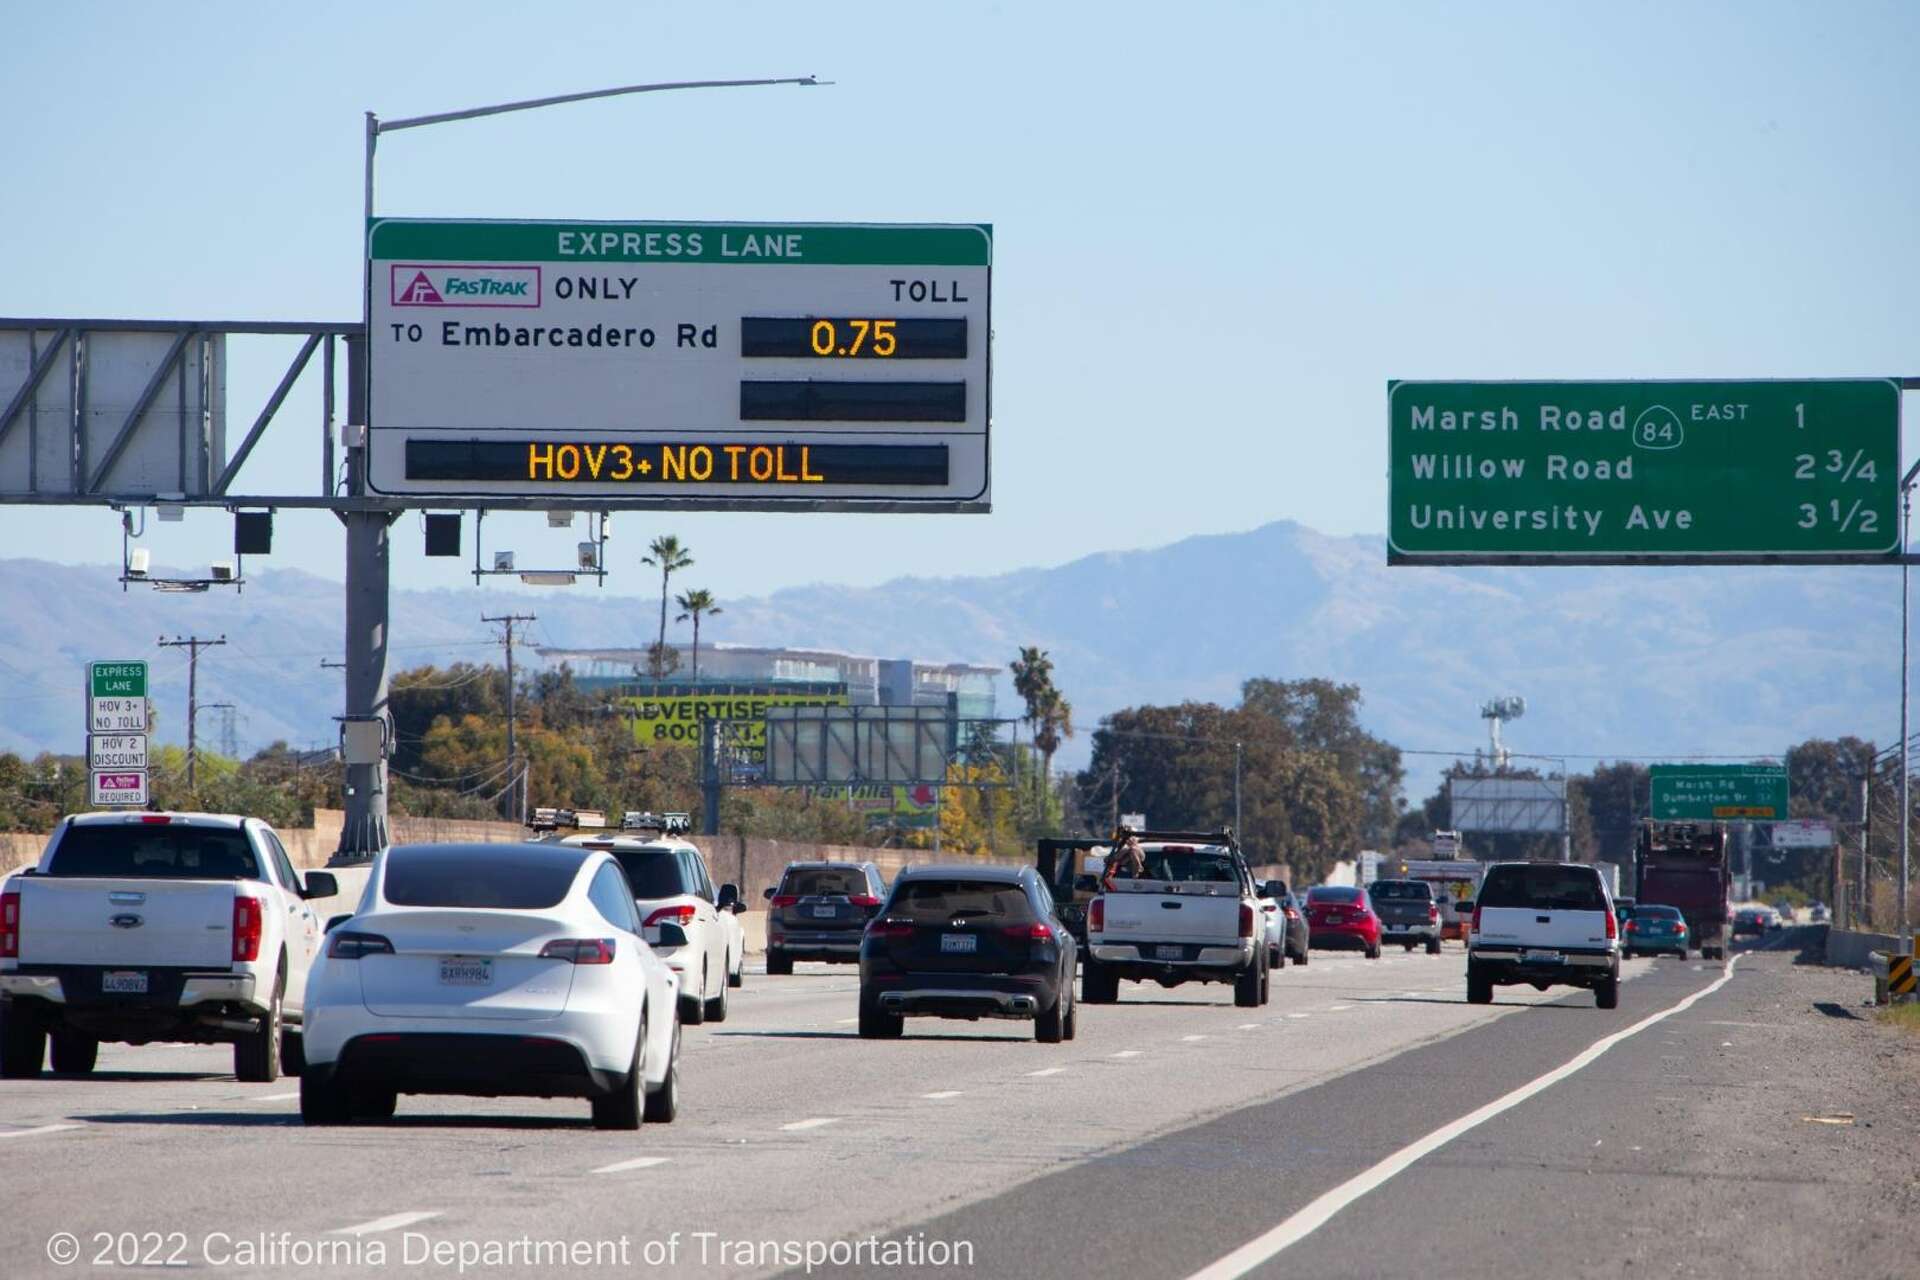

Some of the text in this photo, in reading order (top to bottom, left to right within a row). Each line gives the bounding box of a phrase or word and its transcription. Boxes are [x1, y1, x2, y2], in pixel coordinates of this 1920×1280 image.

[557, 232, 804, 259] EXPRESS LANE
[555, 278, 638, 300] ONLY
[890, 280, 969, 303] TOLL
[391, 322, 718, 349] TO Embarcadero Rd
[811, 320, 897, 356] 0.75
[1411, 403, 1805, 441] Marsh Road 84 EAST 1
[528, 444, 824, 482] HOV3+ NO TOLL
[1411, 455, 1525, 480] Willow
[1547, 456, 1633, 479] Road
[1795, 455, 1816, 479] 2
[1411, 505, 1602, 535] University
[1625, 506, 1693, 530] Ave
[1798, 504, 1818, 529] 3
[96, 667, 142, 677] EXPRESS
[106, 681, 132, 691] LANE
[99, 701, 137, 712] HOV 3+
[625, 701, 766, 720] ADVERTISE
[96, 717, 142, 728] NO TOLL
[102, 738, 137, 749] HOV 2
[95, 754, 144, 765] DISCOUNT
[99, 792, 141, 801] REQUIRED
